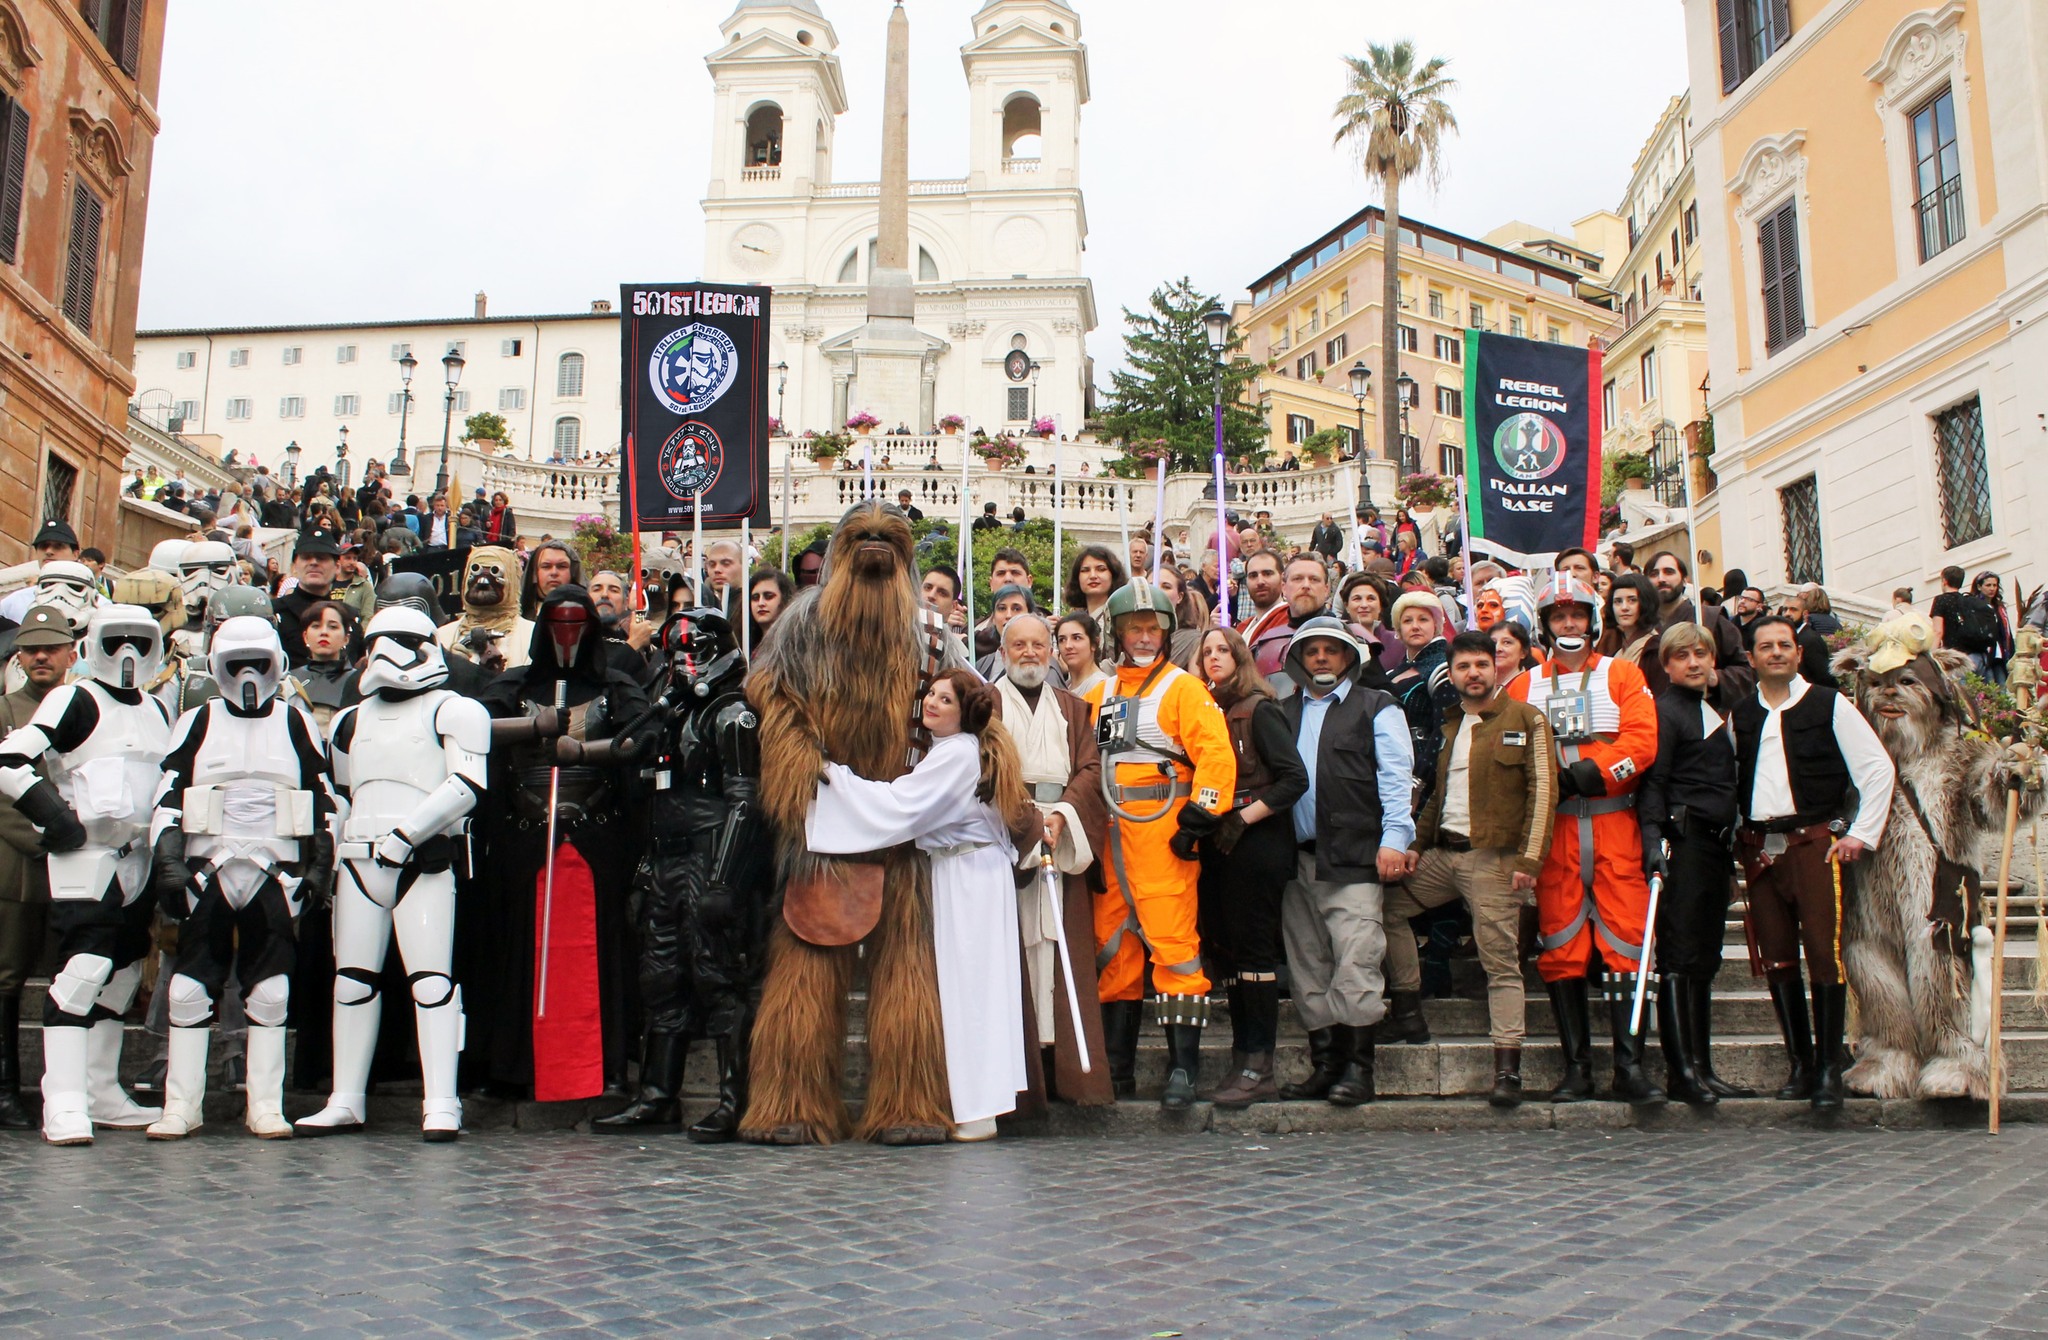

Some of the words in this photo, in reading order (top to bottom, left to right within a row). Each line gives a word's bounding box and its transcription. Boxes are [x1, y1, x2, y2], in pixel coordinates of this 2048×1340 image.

[694, 290, 760, 317] LEGION
[653, 328, 688, 360] ITALICA
[692, 323, 734, 353] GARRISON
[1499, 378, 1565, 398] REBEL
[689, 395, 716, 411] LEGION
[1495, 393, 1568, 413] LEGION
[1490, 478, 1567, 497] ITALIAN
[1501, 496, 1554, 513] BASE
